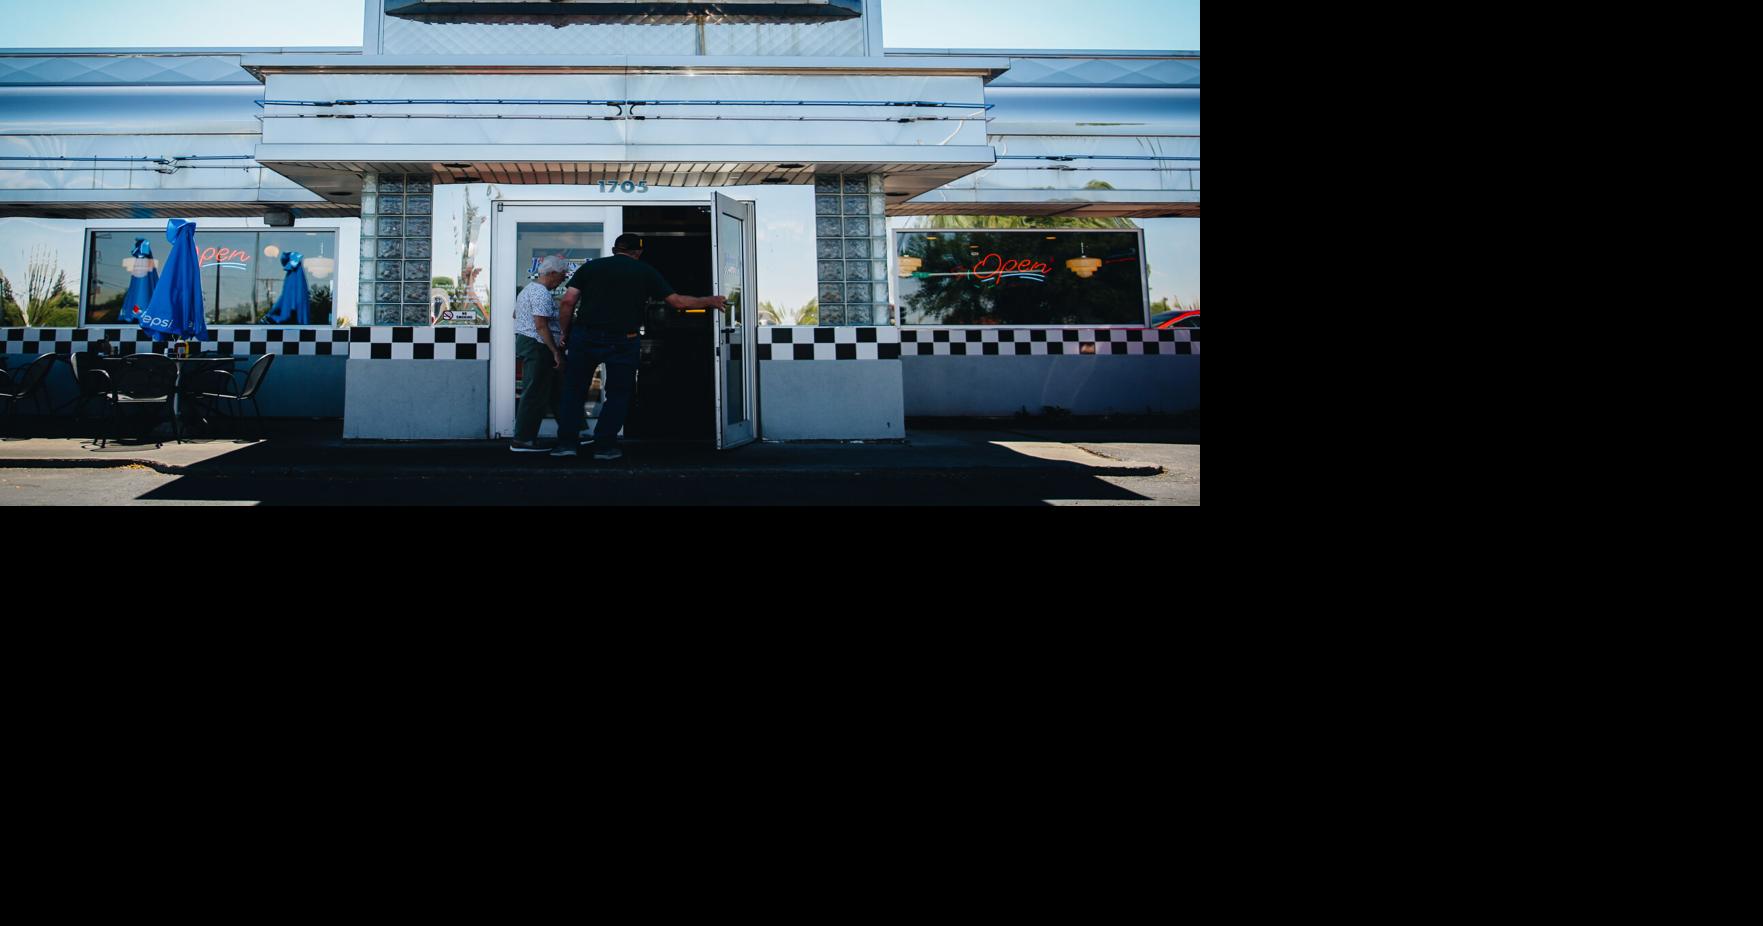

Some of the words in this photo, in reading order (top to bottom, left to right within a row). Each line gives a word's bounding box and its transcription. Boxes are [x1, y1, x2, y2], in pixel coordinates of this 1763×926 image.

[598, 180, 648, 193] 1705
[195, 246, 250, 268] pen
[974, 253, 1052, 285] Open
